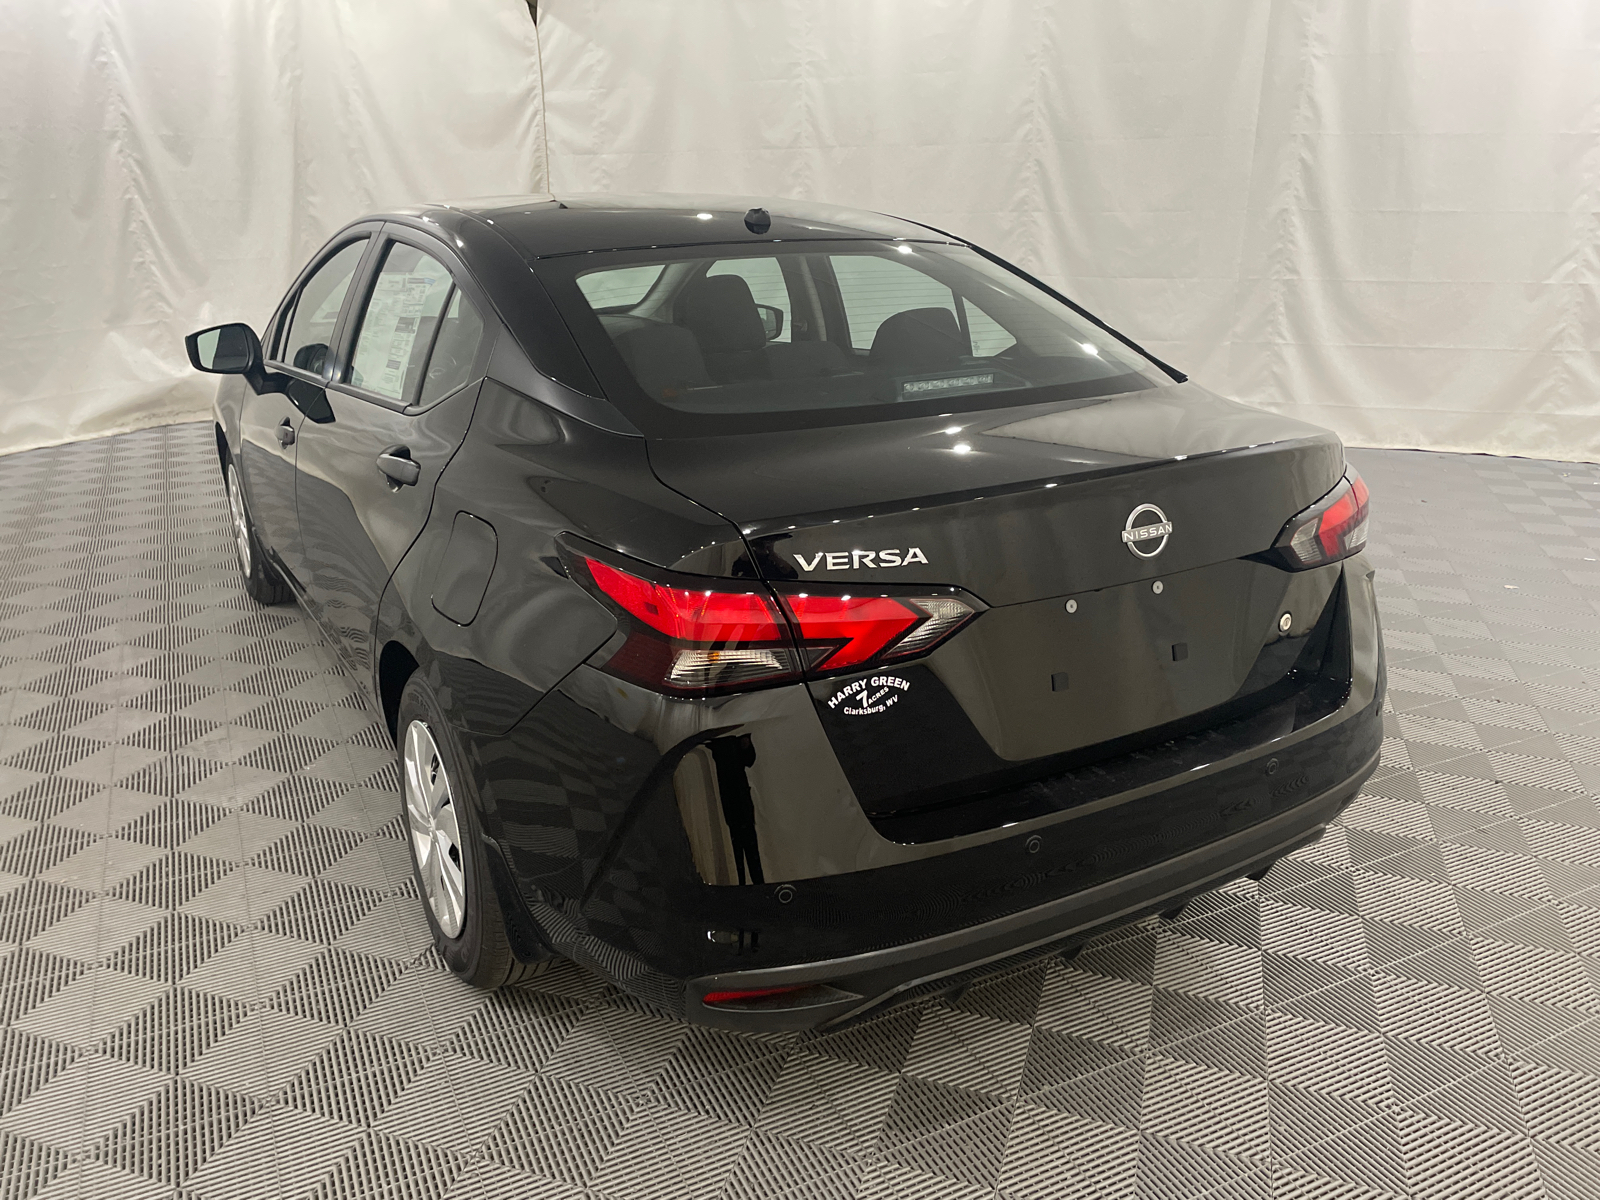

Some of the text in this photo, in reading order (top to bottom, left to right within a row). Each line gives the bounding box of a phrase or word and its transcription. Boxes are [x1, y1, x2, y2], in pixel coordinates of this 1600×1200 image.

[1123, 524, 1172, 541] NISSAN
[793, 547, 929, 572] VERSA
[827, 676, 910, 709] HARRY GREEN
[855, 686, 890, 709] 7 ACRES
[843, 694, 899, 716] Clarksburg, WV
